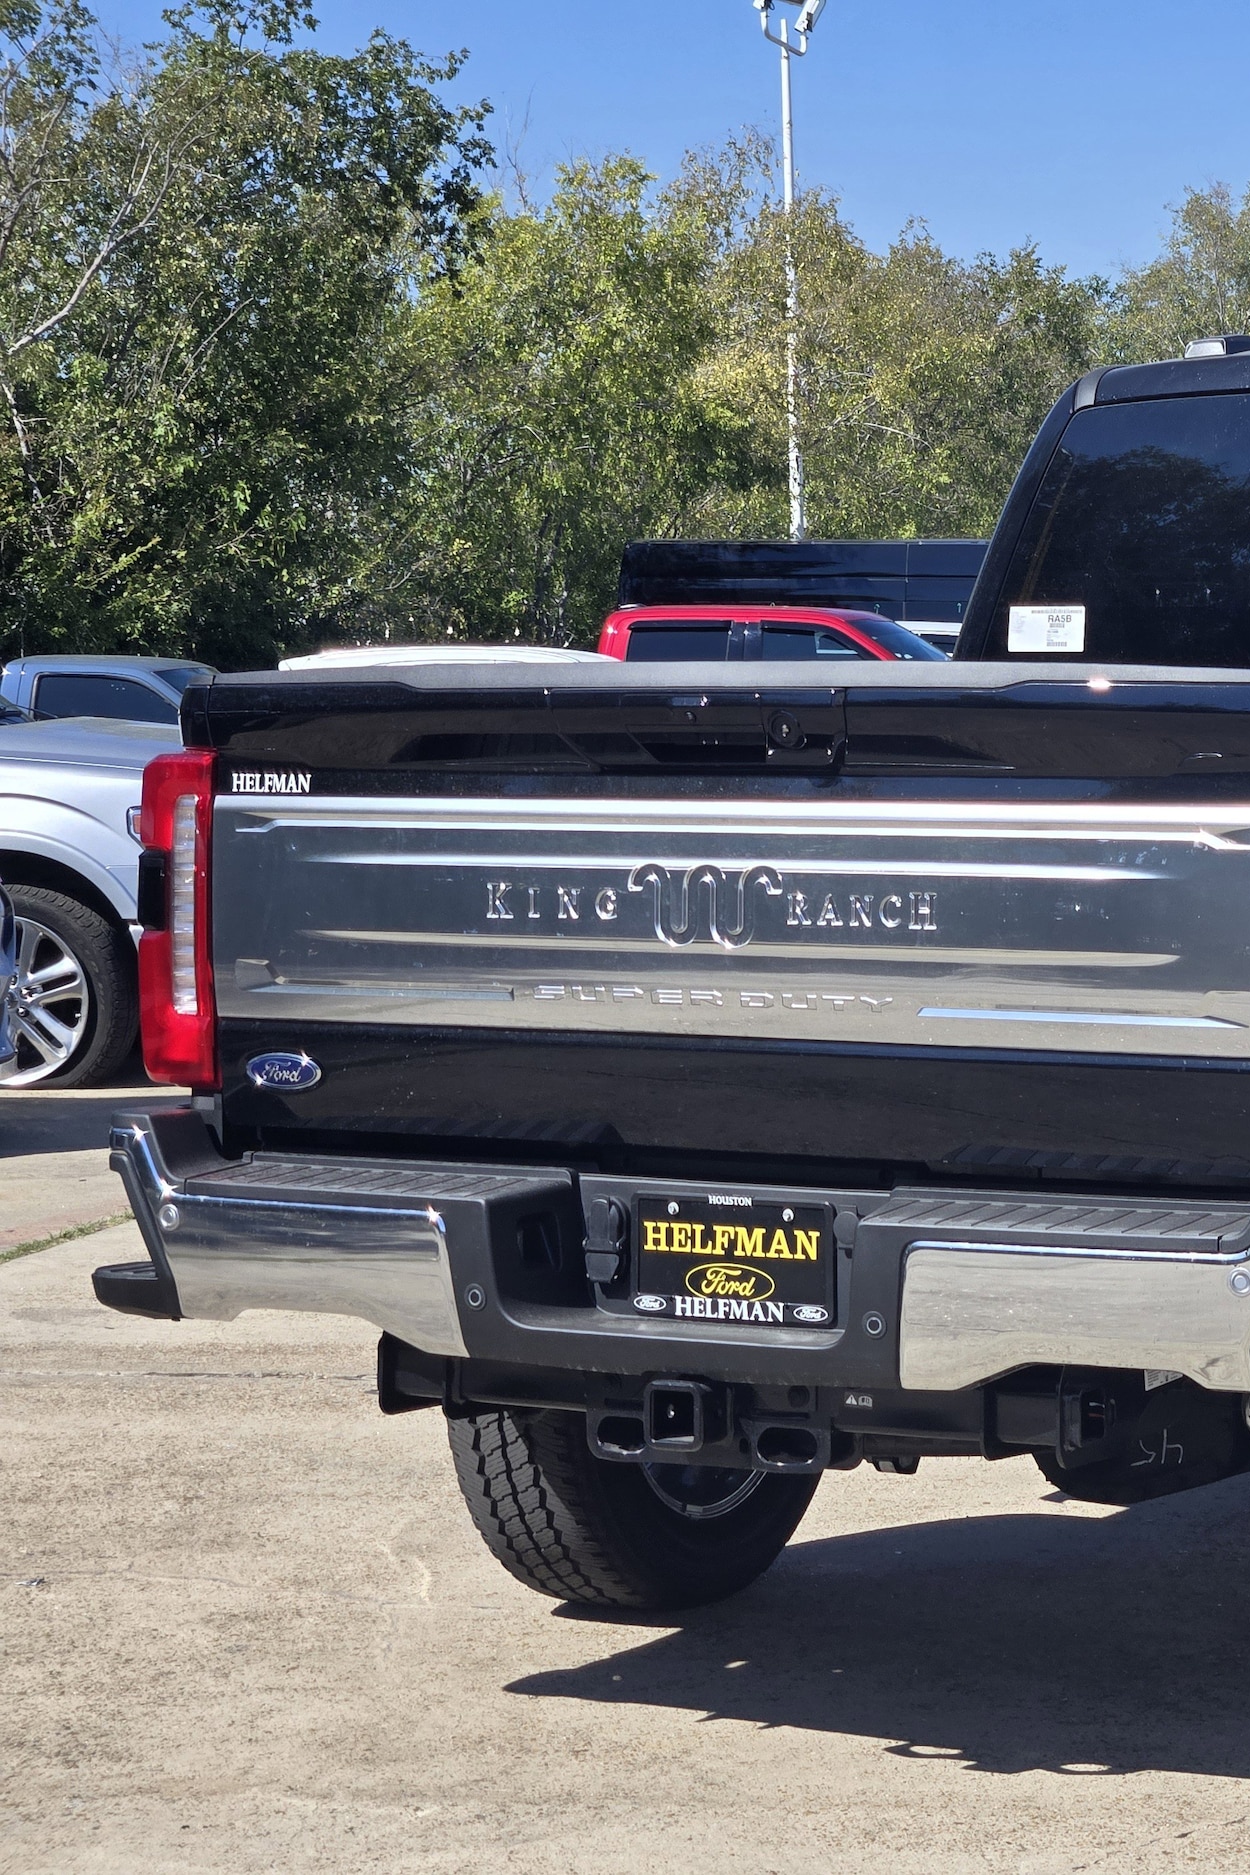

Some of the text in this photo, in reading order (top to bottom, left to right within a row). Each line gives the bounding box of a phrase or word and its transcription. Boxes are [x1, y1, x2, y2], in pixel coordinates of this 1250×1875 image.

[231, 773, 312, 793] HELFMAN
[486, 882, 938, 930] KING RANCH
[533, 984, 893, 1013] SUPER DUTY
[262, 1060, 302, 1082] Ford
[708, 1195, 752, 1207] HOUSTON
[643, 1221, 821, 1261] HELFMAN
[701, 1267, 756, 1296] Ford
[639, 1298, 661, 1309] Ford
[674, 1296, 785, 1323] HELFMAN
[798, 1306, 822, 1319] Ford
